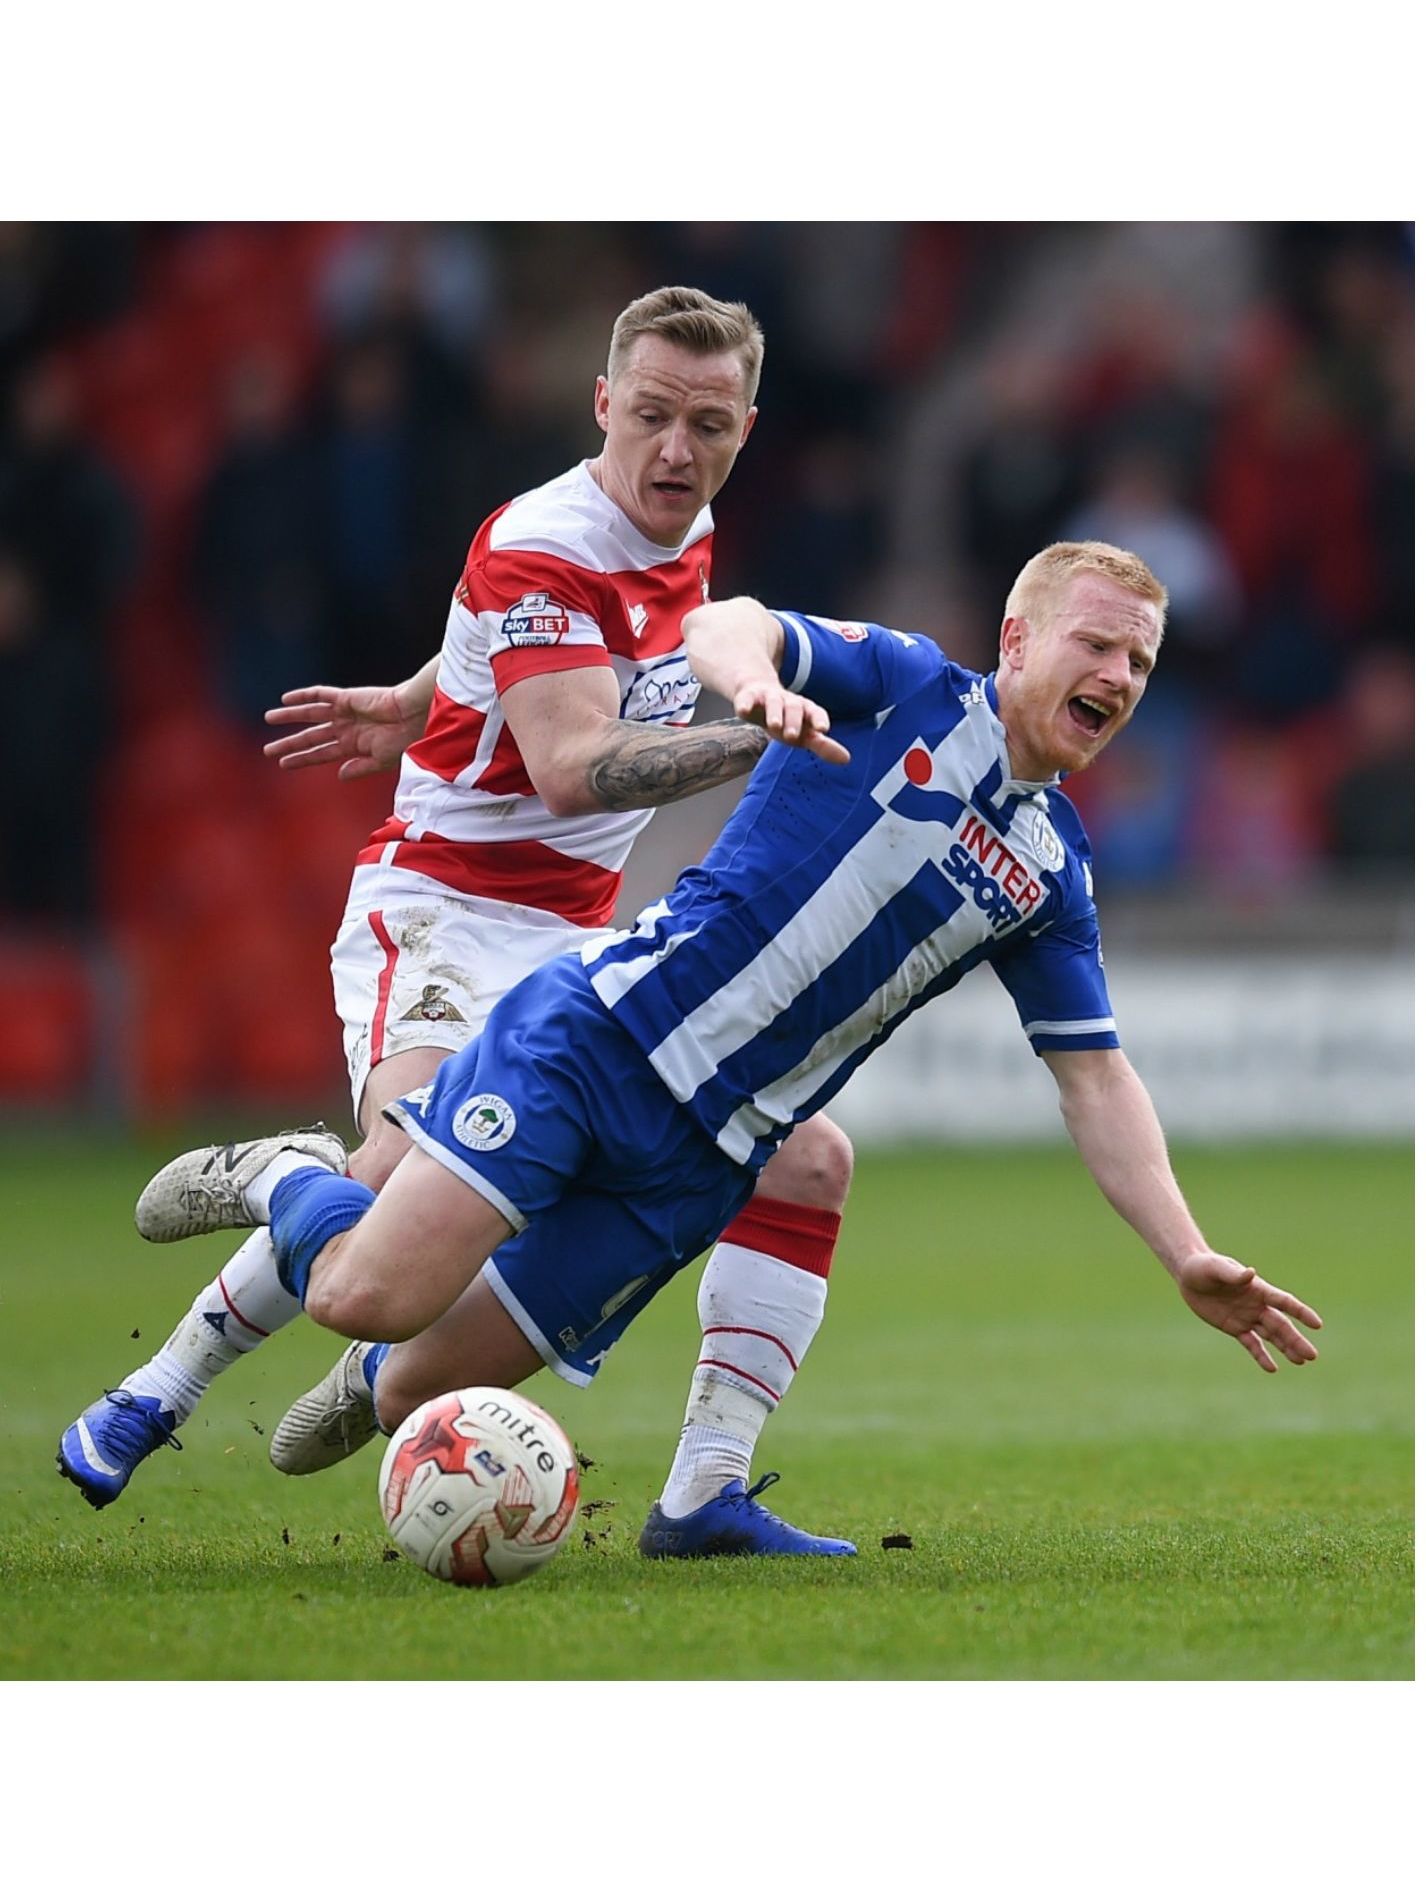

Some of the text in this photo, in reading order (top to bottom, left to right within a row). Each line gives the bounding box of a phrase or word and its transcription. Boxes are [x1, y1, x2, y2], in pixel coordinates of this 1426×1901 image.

[504, 617, 566, 632] sky BET
[959, 816, 1040, 915] INTER
[480, 1096, 513, 1121] WIGAN
[478, 1401, 555, 1473] mitre
